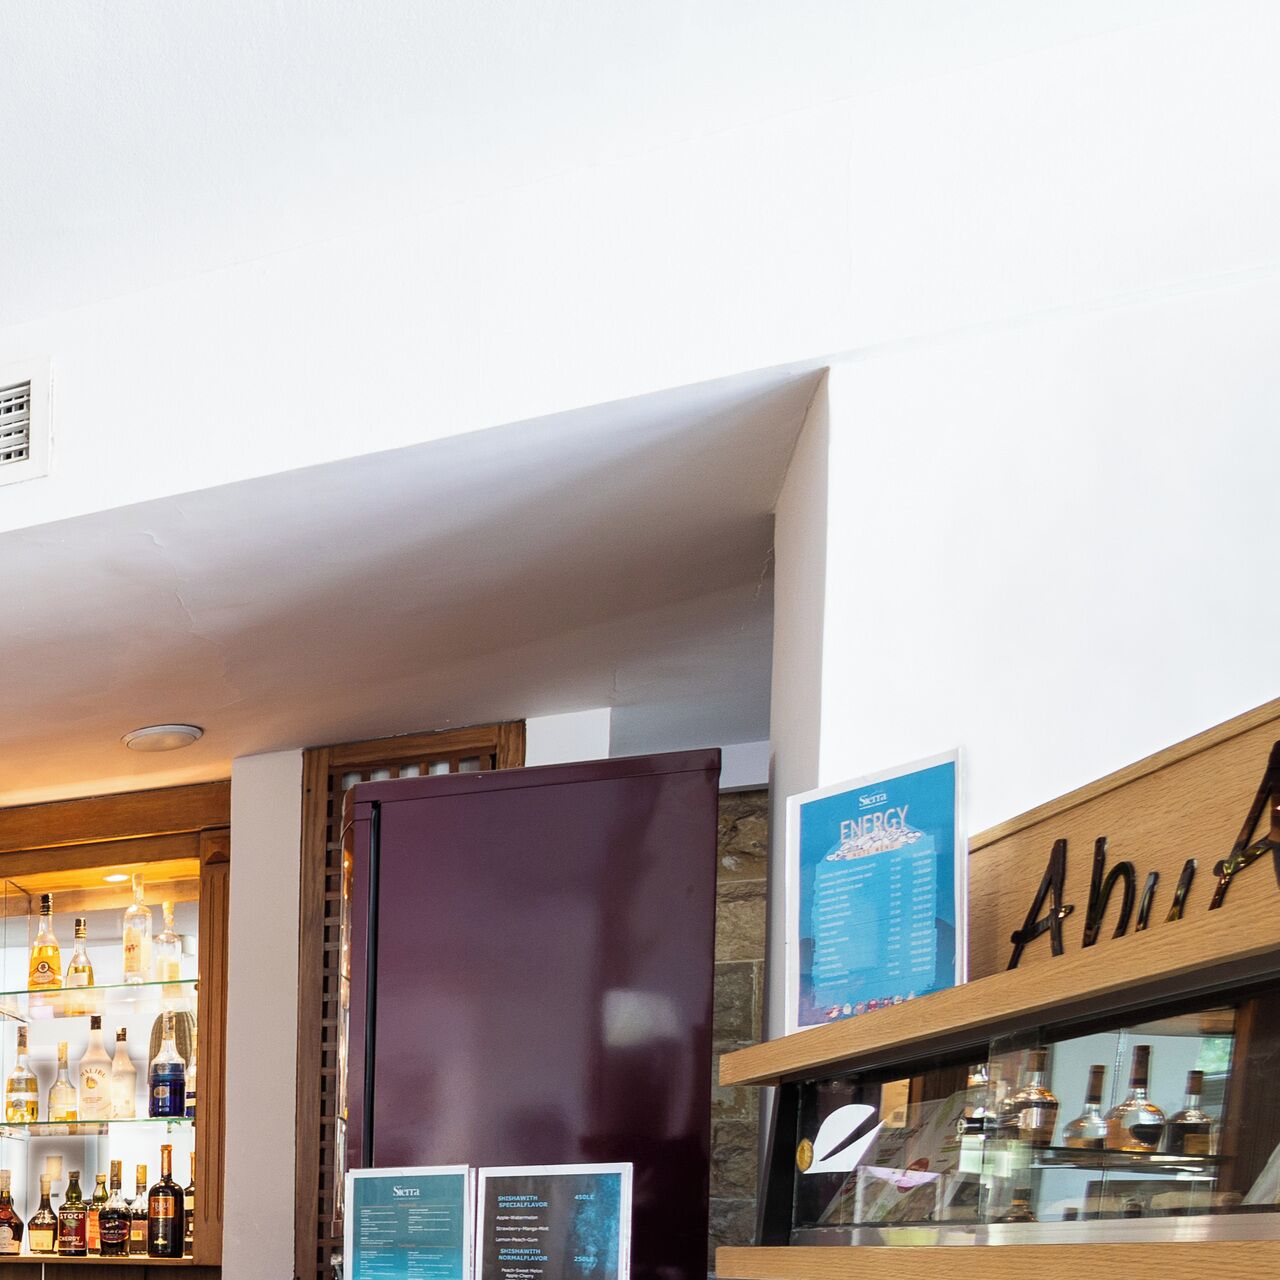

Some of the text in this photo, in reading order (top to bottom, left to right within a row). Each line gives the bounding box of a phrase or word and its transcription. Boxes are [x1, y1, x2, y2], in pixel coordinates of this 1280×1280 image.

[859, 793, 887, 806] Sierra
[840, 805, 909, 841] ENERGY
[80, 1068, 106, 1079] MALIBU
[393, 1186, 420, 1196] Sierra
